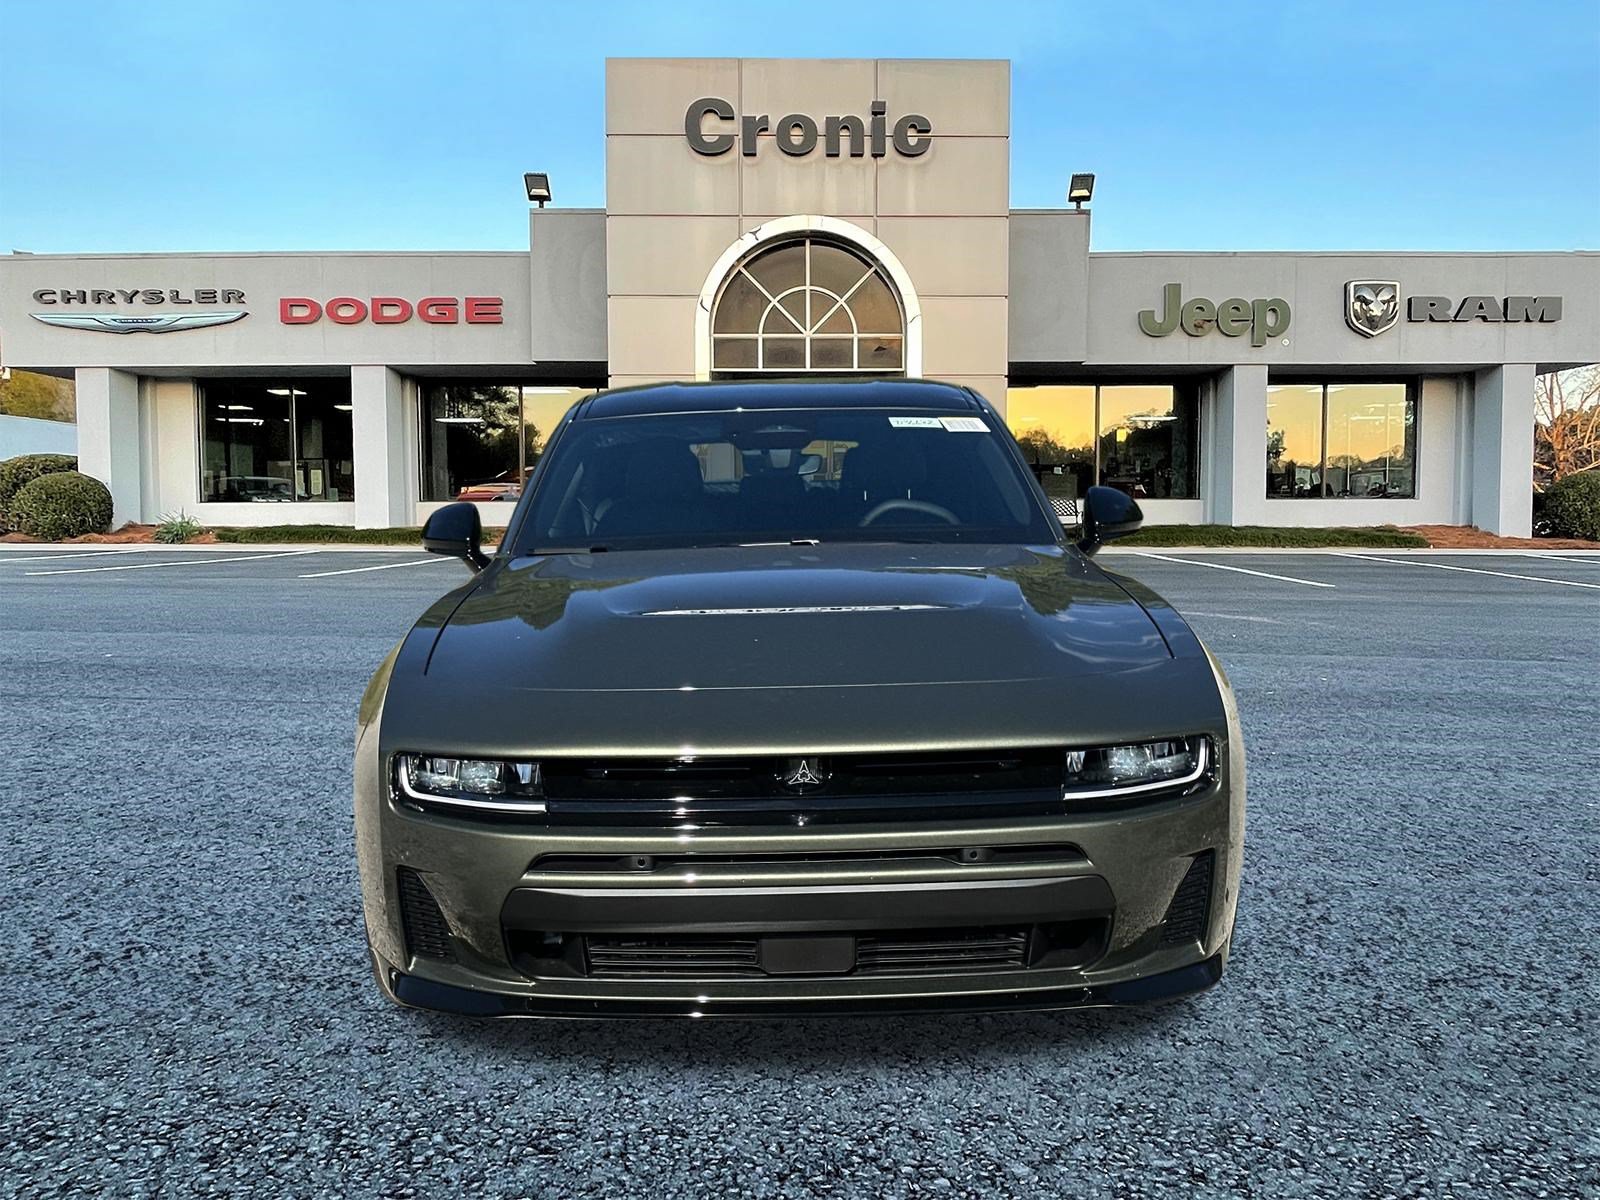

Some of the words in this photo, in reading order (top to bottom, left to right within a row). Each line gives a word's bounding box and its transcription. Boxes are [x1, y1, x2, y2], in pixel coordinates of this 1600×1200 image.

[685, 97, 932, 157] Cronic
[33, 288, 246, 304] CHRYSLER
[1407, 296, 1563, 322] RAM
[279, 297, 504, 325] DODGE
[1138, 283, 1292, 347] Jeep
